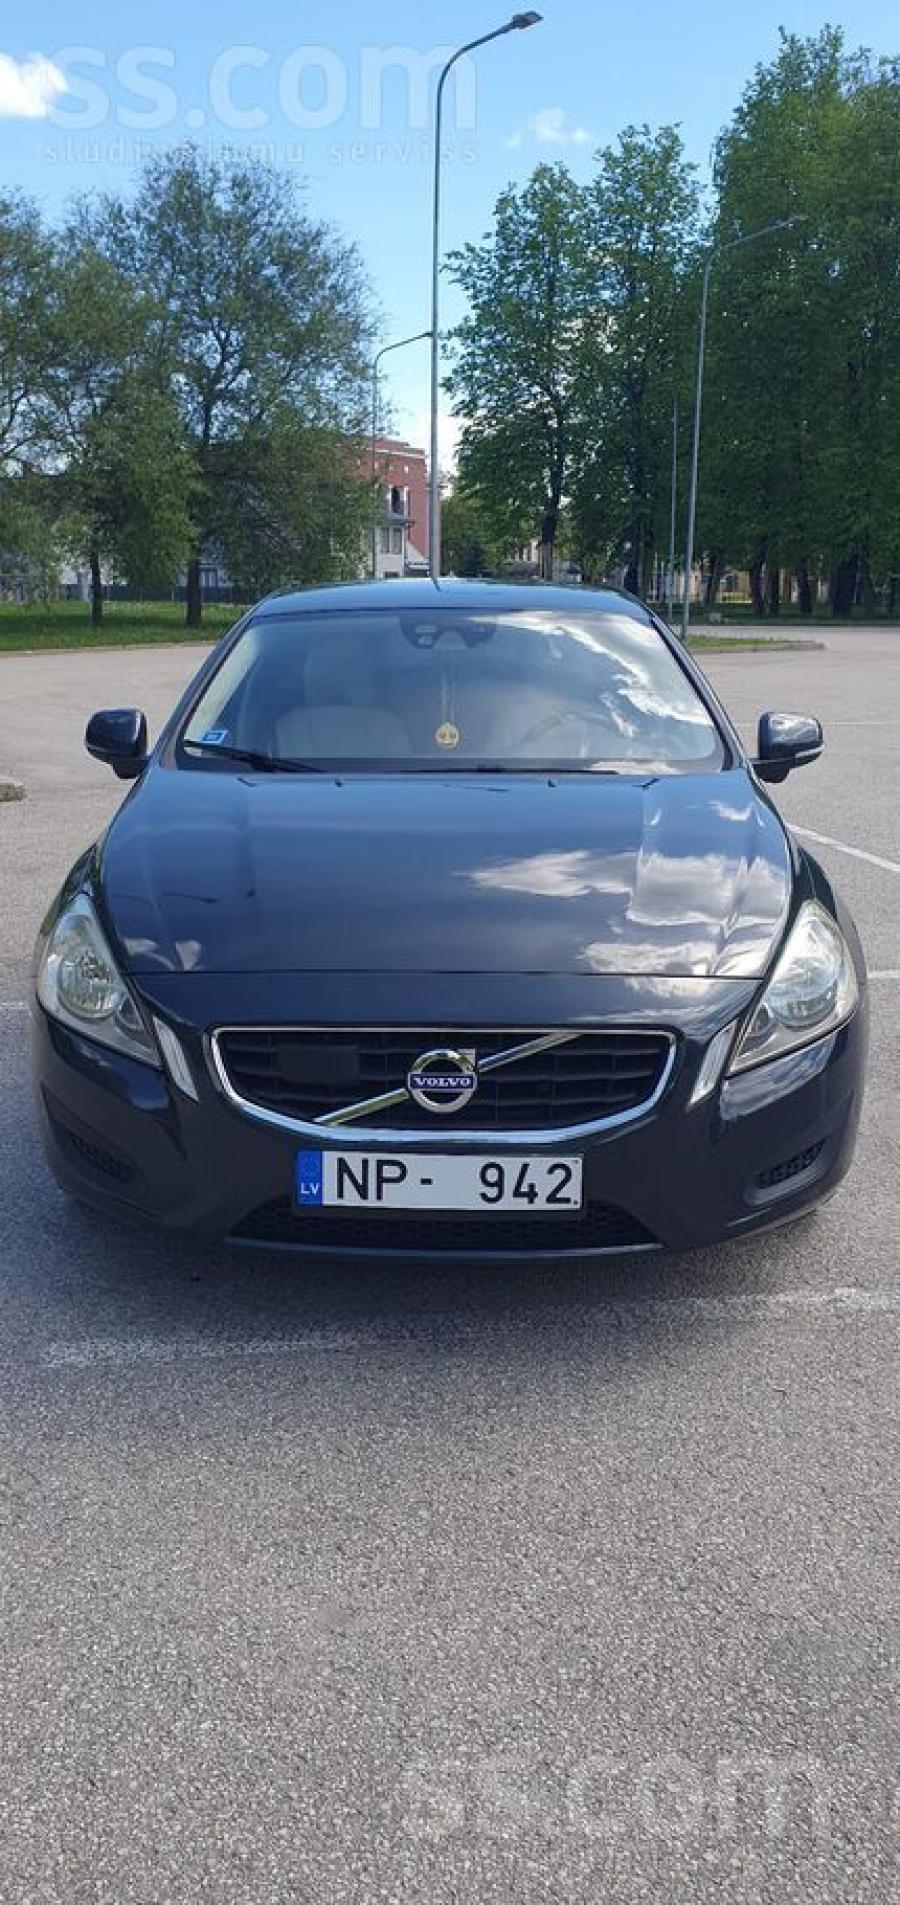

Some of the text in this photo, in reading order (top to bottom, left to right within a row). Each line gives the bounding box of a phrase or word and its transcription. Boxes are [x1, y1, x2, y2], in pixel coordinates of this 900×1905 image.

[413, 1077, 472, 1088] VOLVO
[479, 1161, 574, 1205] 942
[300, 1185, 319, 1195] LV
